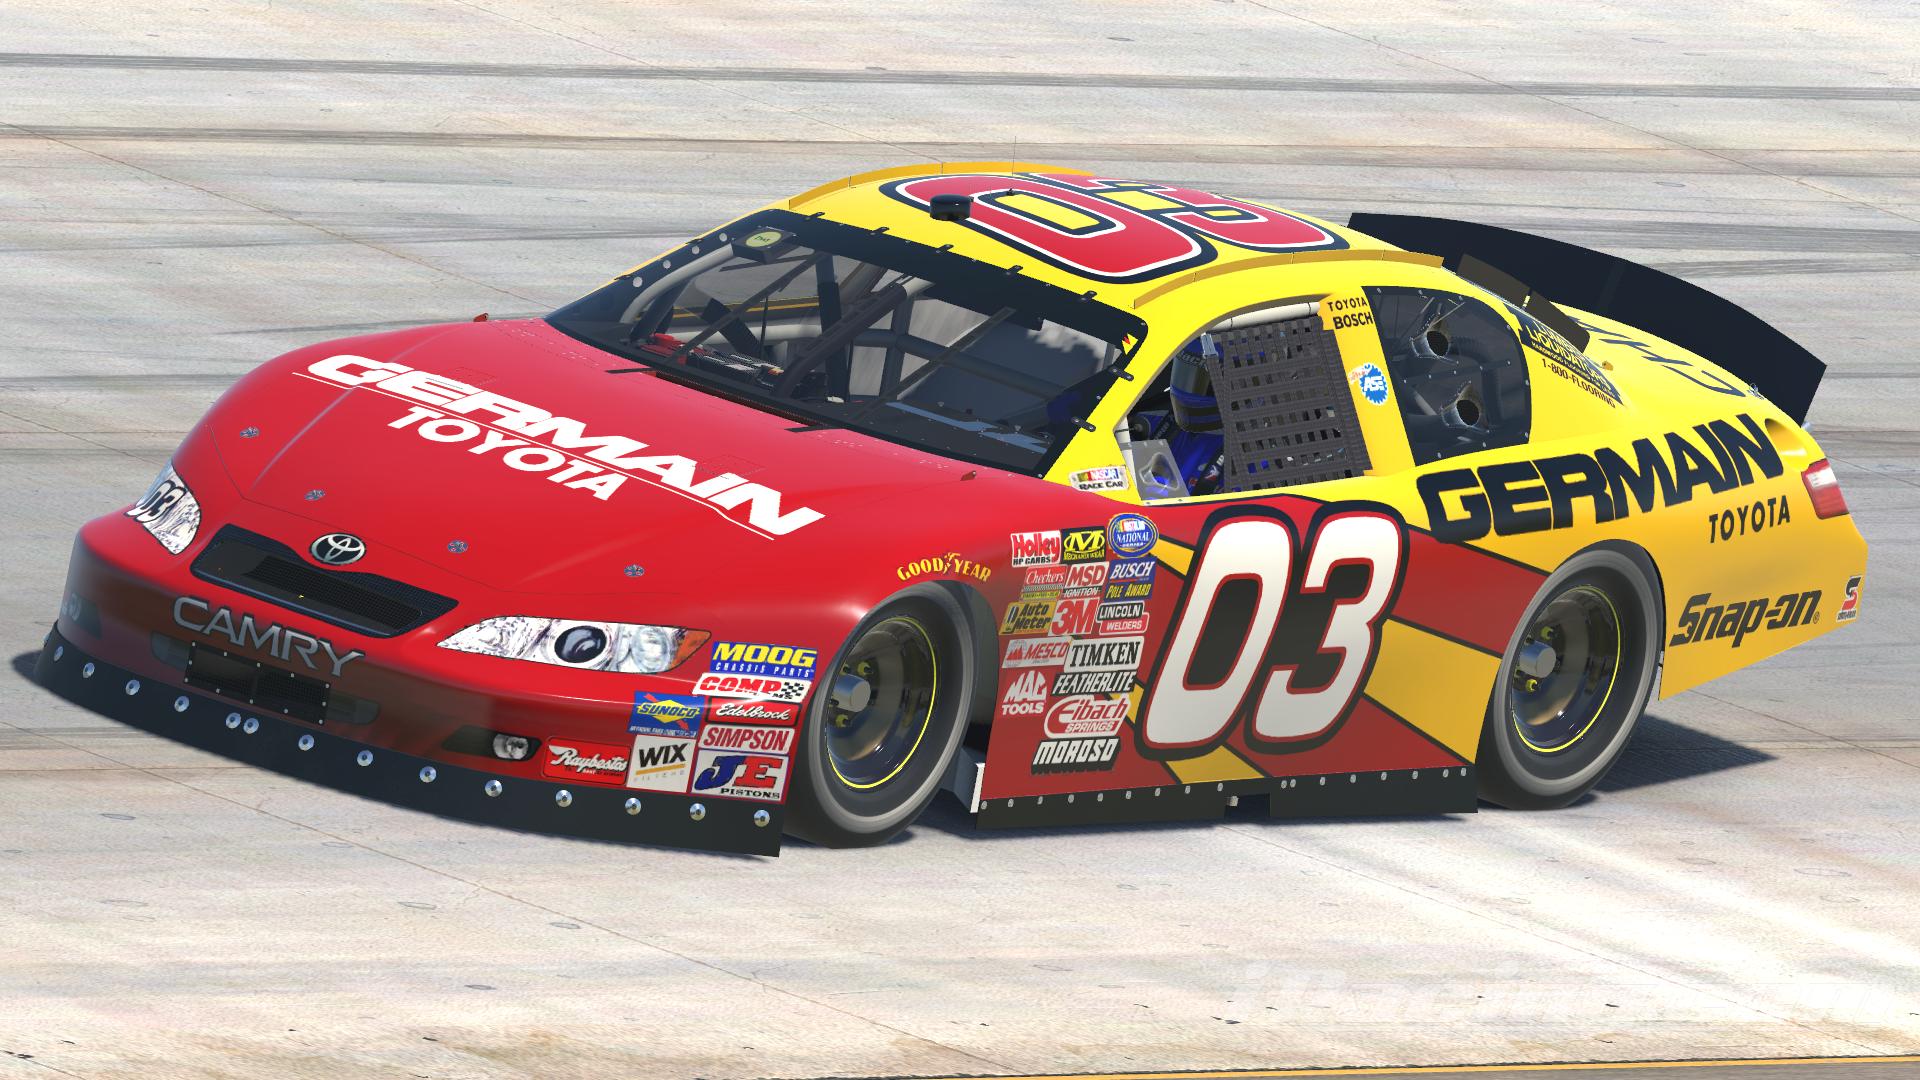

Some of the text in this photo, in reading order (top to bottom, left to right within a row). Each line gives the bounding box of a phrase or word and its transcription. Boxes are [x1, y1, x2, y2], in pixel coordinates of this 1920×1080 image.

[1328, 297, 1367, 311] TOYOTA
[1333, 311, 1374, 329] BOSCH
[1526, 325, 1611, 390] LIQUIDAT
[1542, 358, 1616, 408] 1-800-FLOORING
[308, 355, 826, 535] GERMAIN
[388, 405, 628, 501] TOYOTA
[1416, 413, 1784, 544] GERMAIN
[124, 480, 187, 523] 03
[1708, 495, 1790, 543] TOYOTA
[1013, 535, 1060, 559] Holley
[1116, 531, 1150, 543] NATIONAL
[1013, 556, 1051, 566] HP CARBS
[1110, 561, 1155, 580] BUSCH
[1026, 569, 1065, 585] Checkers
[1066, 565, 1106, 587] MSD
[1063, 587, 1099, 598] IGNITION
[1106, 583, 1152, 599] POLE AWARD
[1020, 602, 1050, 617] Auto
[1051, 600, 1099, 636] 3M
[1099, 604, 1141, 619] LINCOLN
[1014, 617, 1052, 630] Meter
[1106, 620, 1143, 631] WELDERS
[1134, 500, 1410, 761] 03
[173, 596, 366, 677] CAMRY
[713, 643, 817, 668] MOOG
[1024, 642, 1069, 659] MESCO
[1069, 641, 1140, 667] TIMKEN
[715, 662, 766, 674] CHASSIS
[700, 676, 782, 693] COMP
[1003, 670, 1047, 703] MAC
[1052, 671, 1136, 695] FEATHERLITE
[640, 704, 698, 718] SUNOCO
[715, 702, 792, 720] Edelbrock
[1002, 702, 1045, 716] TOOLS
[1047, 697, 1129, 722] Eibach
[1065, 722, 1116, 733] SPRINGS
[703, 727, 790, 751] SIMPSON
[639, 743, 689, 768] WIX
[1032, 738, 1119, 766] MOROSO
[694, 755, 784, 791] JE
[720, 788, 781, 799] PISTONS
